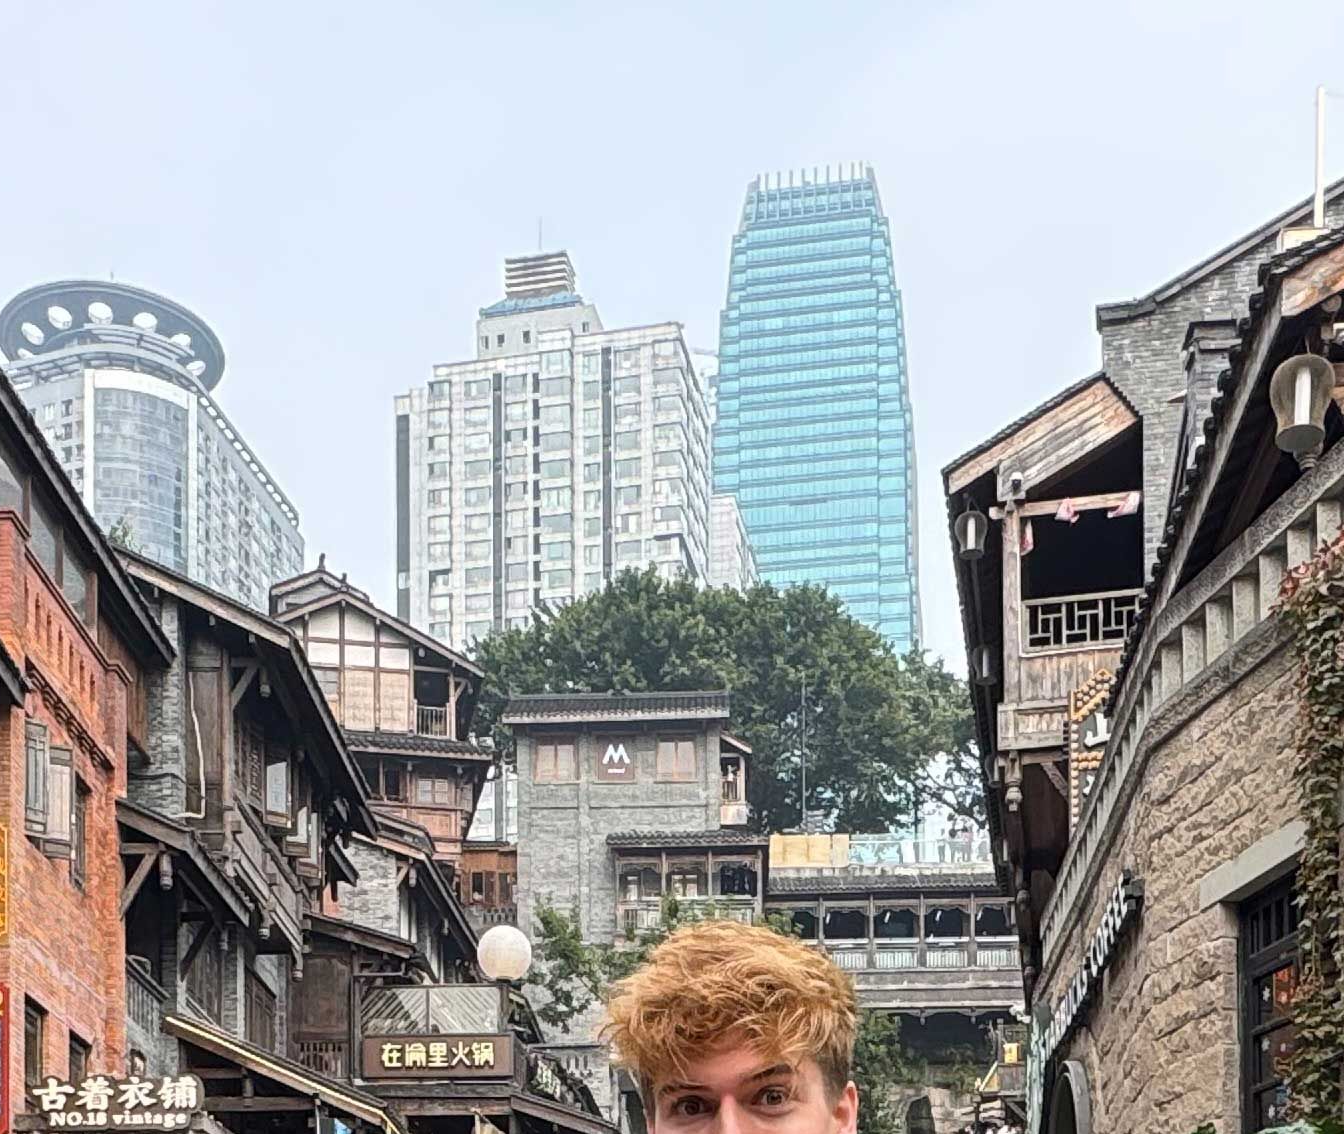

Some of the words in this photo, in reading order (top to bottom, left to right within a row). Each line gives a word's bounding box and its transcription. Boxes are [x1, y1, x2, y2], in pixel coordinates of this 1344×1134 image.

[1089, 870, 1129, 978] COFFEE
[381, 1041, 495, 1068] 在渝里火锅
[32, 1076, 198, 1112] 古着衣铺
[112, 1110, 187, 1128] vintage
